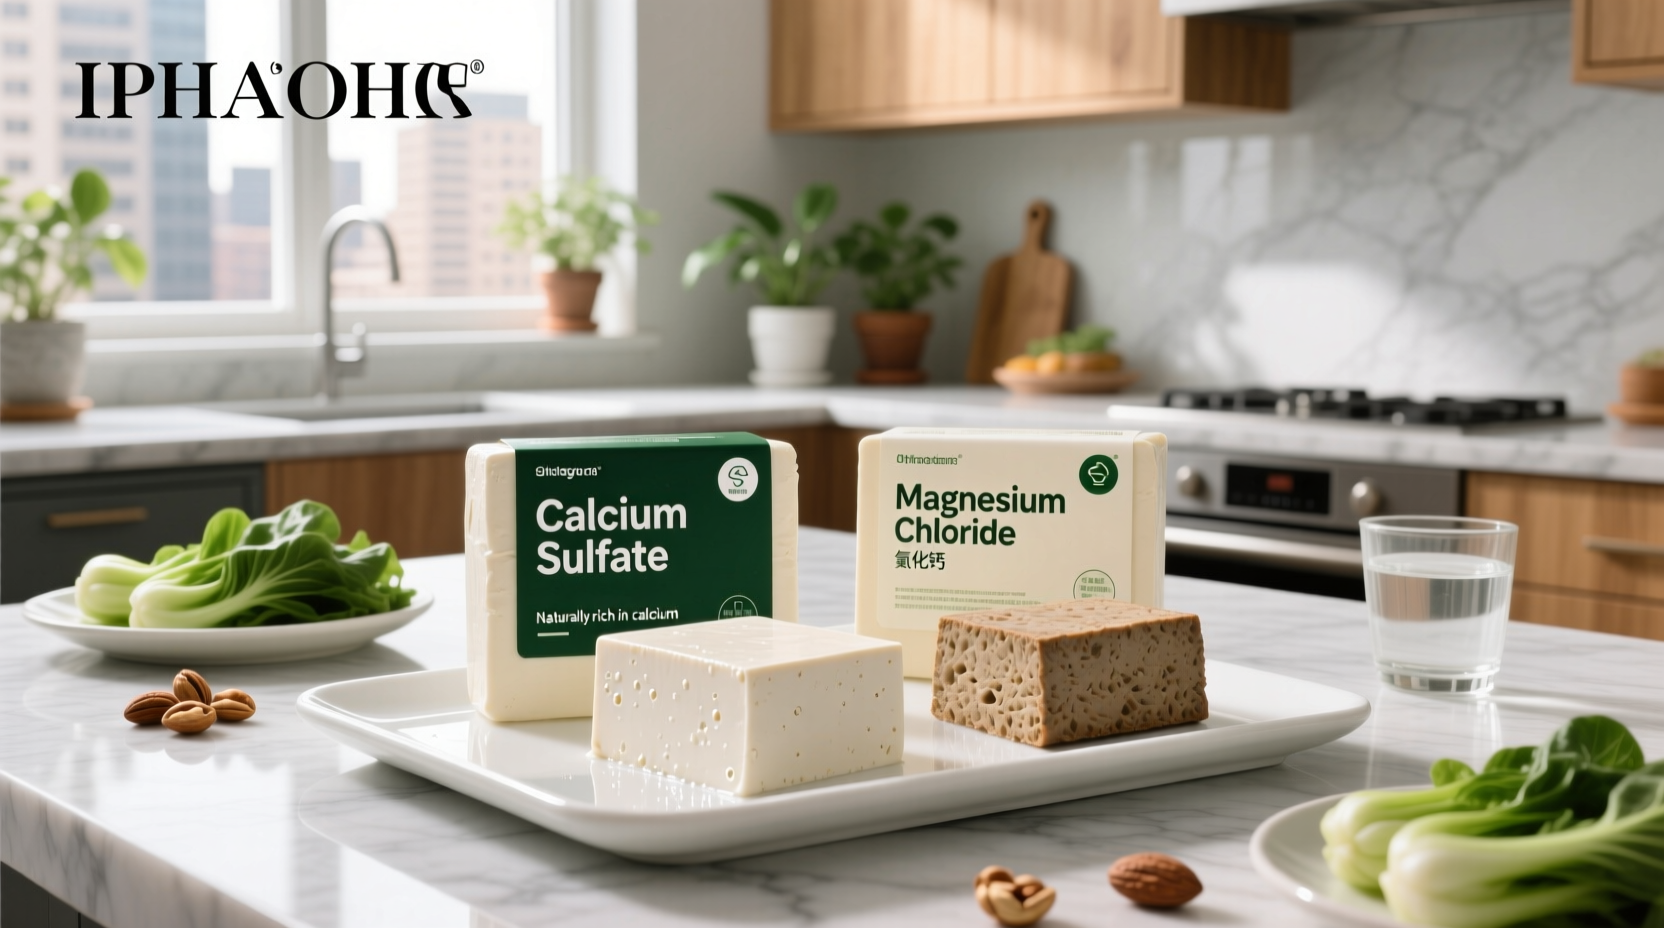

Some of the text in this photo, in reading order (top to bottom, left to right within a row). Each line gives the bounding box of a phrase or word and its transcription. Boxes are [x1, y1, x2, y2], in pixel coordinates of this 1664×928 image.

[536, 495, 687, 532] Calcium
[896, 483, 1066, 518] Magnesium
[895, 516, 1016, 546] Chloride
[536, 538, 669, 575] Sulfate
[536, 607, 679, 626] Naturally rich in calcium
